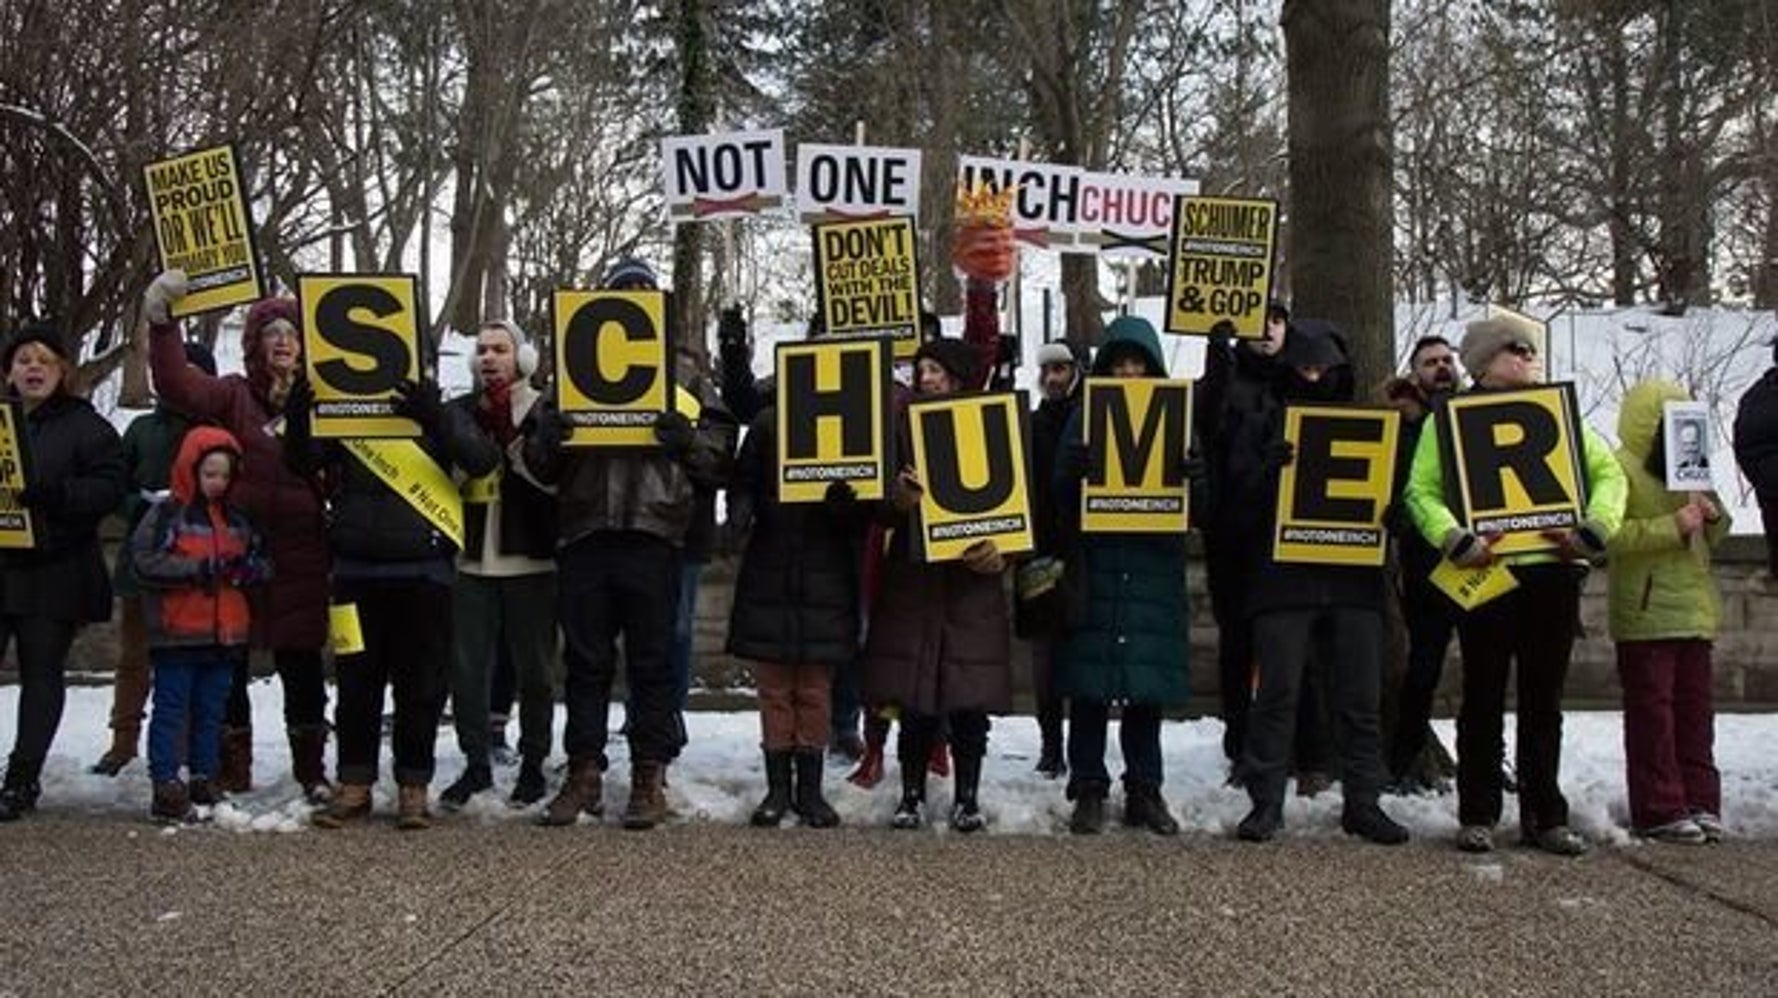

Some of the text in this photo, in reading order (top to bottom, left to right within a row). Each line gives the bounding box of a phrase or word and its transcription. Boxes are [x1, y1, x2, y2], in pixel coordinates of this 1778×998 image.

[150, 152, 231, 192] MAKE US
[676, 140, 772, 195] NOT
[811, 154, 907, 205] ONE
[156, 180, 234, 214] PROUD
[1081, 186, 1171, 228] CHUC
[160, 202, 244, 255] OR WE'LL
[1184, 202, 1271, 240] SCHUMER
[825, 224, 907, 260] DON'T
[826, 256, 910, 281] CUT DEALS
[828, 275, 912, 296] WITH THE
[1181, 257, 1265, 287] TRUMP
[831, 292, 914, 326] DEVIL!
[1178, 286, 1262, 318] & GOP
[313, 283, 412, 395] S
[565, 297, 658, 405] C
[786, 350, 874, 459] H
[1087, 386, 1186, 487] M
[786, 463, 875, 480] #NOTONEINCH
[920, 403, 1016, 515] U
[1291, 416, 1385, 523] E
[1456, 401, 1571, 511] R
[1089, 498, 1180, 511] #NOTONEINCH
[1476, 512, 1574, 533] #NOTONEINCH
[931, 517, 1022, 539] #NOTONEINCH
[1284, 528, 1378, 544] #NOTONEINCH
